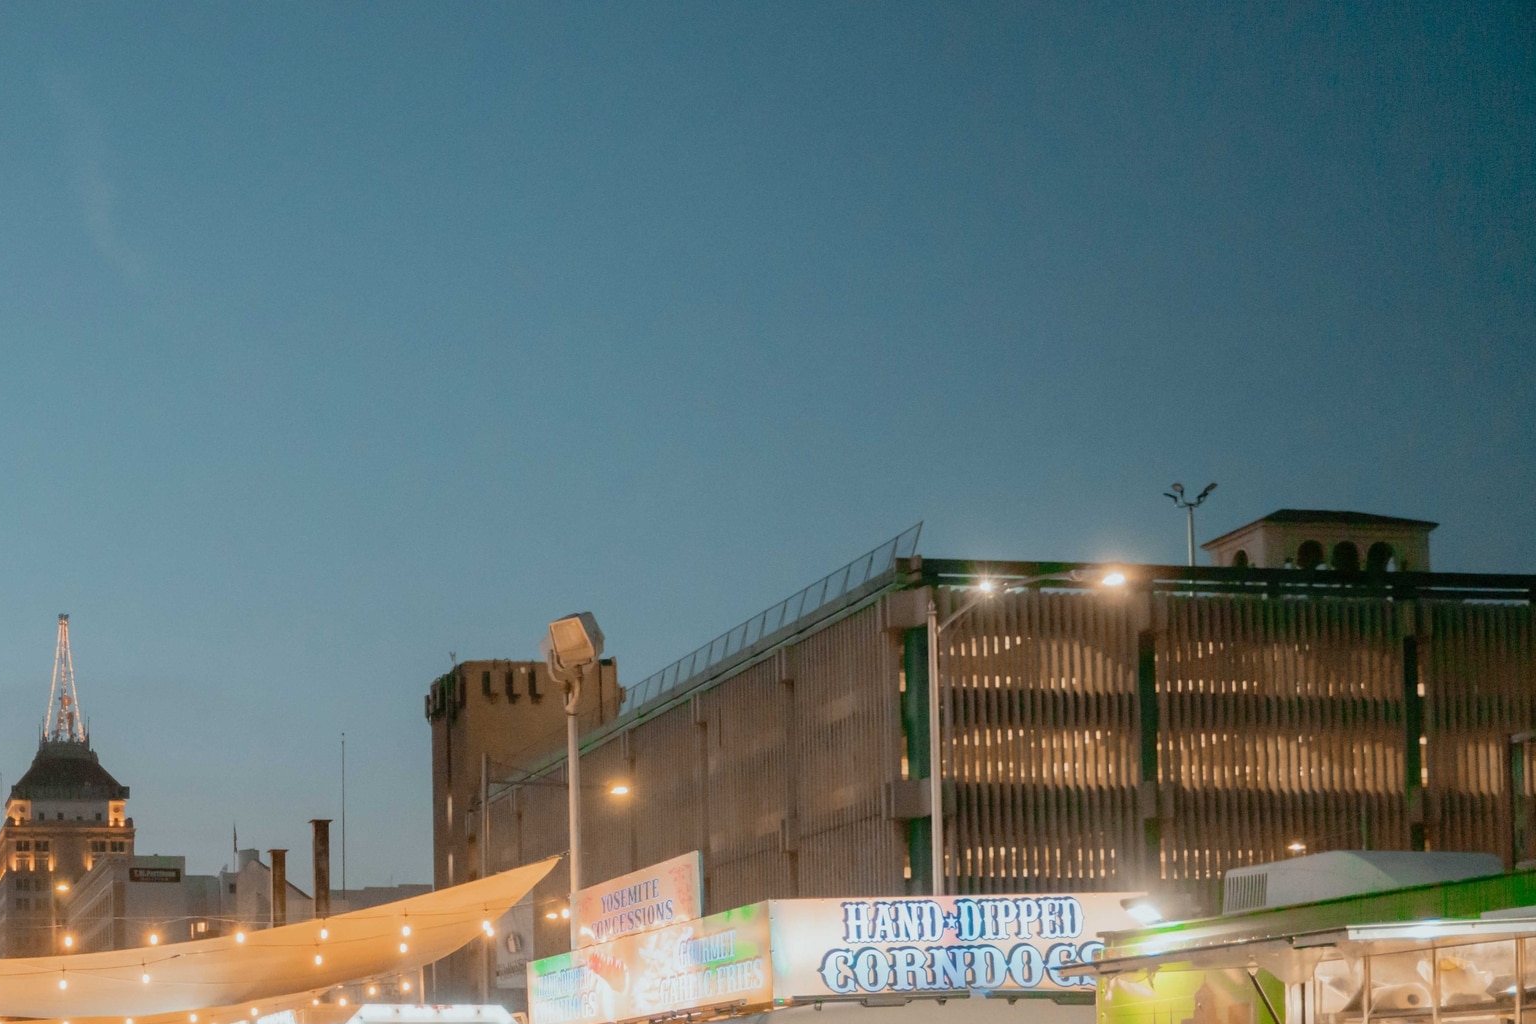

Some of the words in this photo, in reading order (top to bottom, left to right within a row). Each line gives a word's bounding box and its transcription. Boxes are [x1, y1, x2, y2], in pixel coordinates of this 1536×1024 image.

[601, 878, 660, 914] YOSEMITE
[591, 900, 673, 940] CONCESSIONS
[840, 900, 945, 943] HAND
[954, 896, 1085, 940] DIPPED
[715, 955, 764, 997] FRIES
